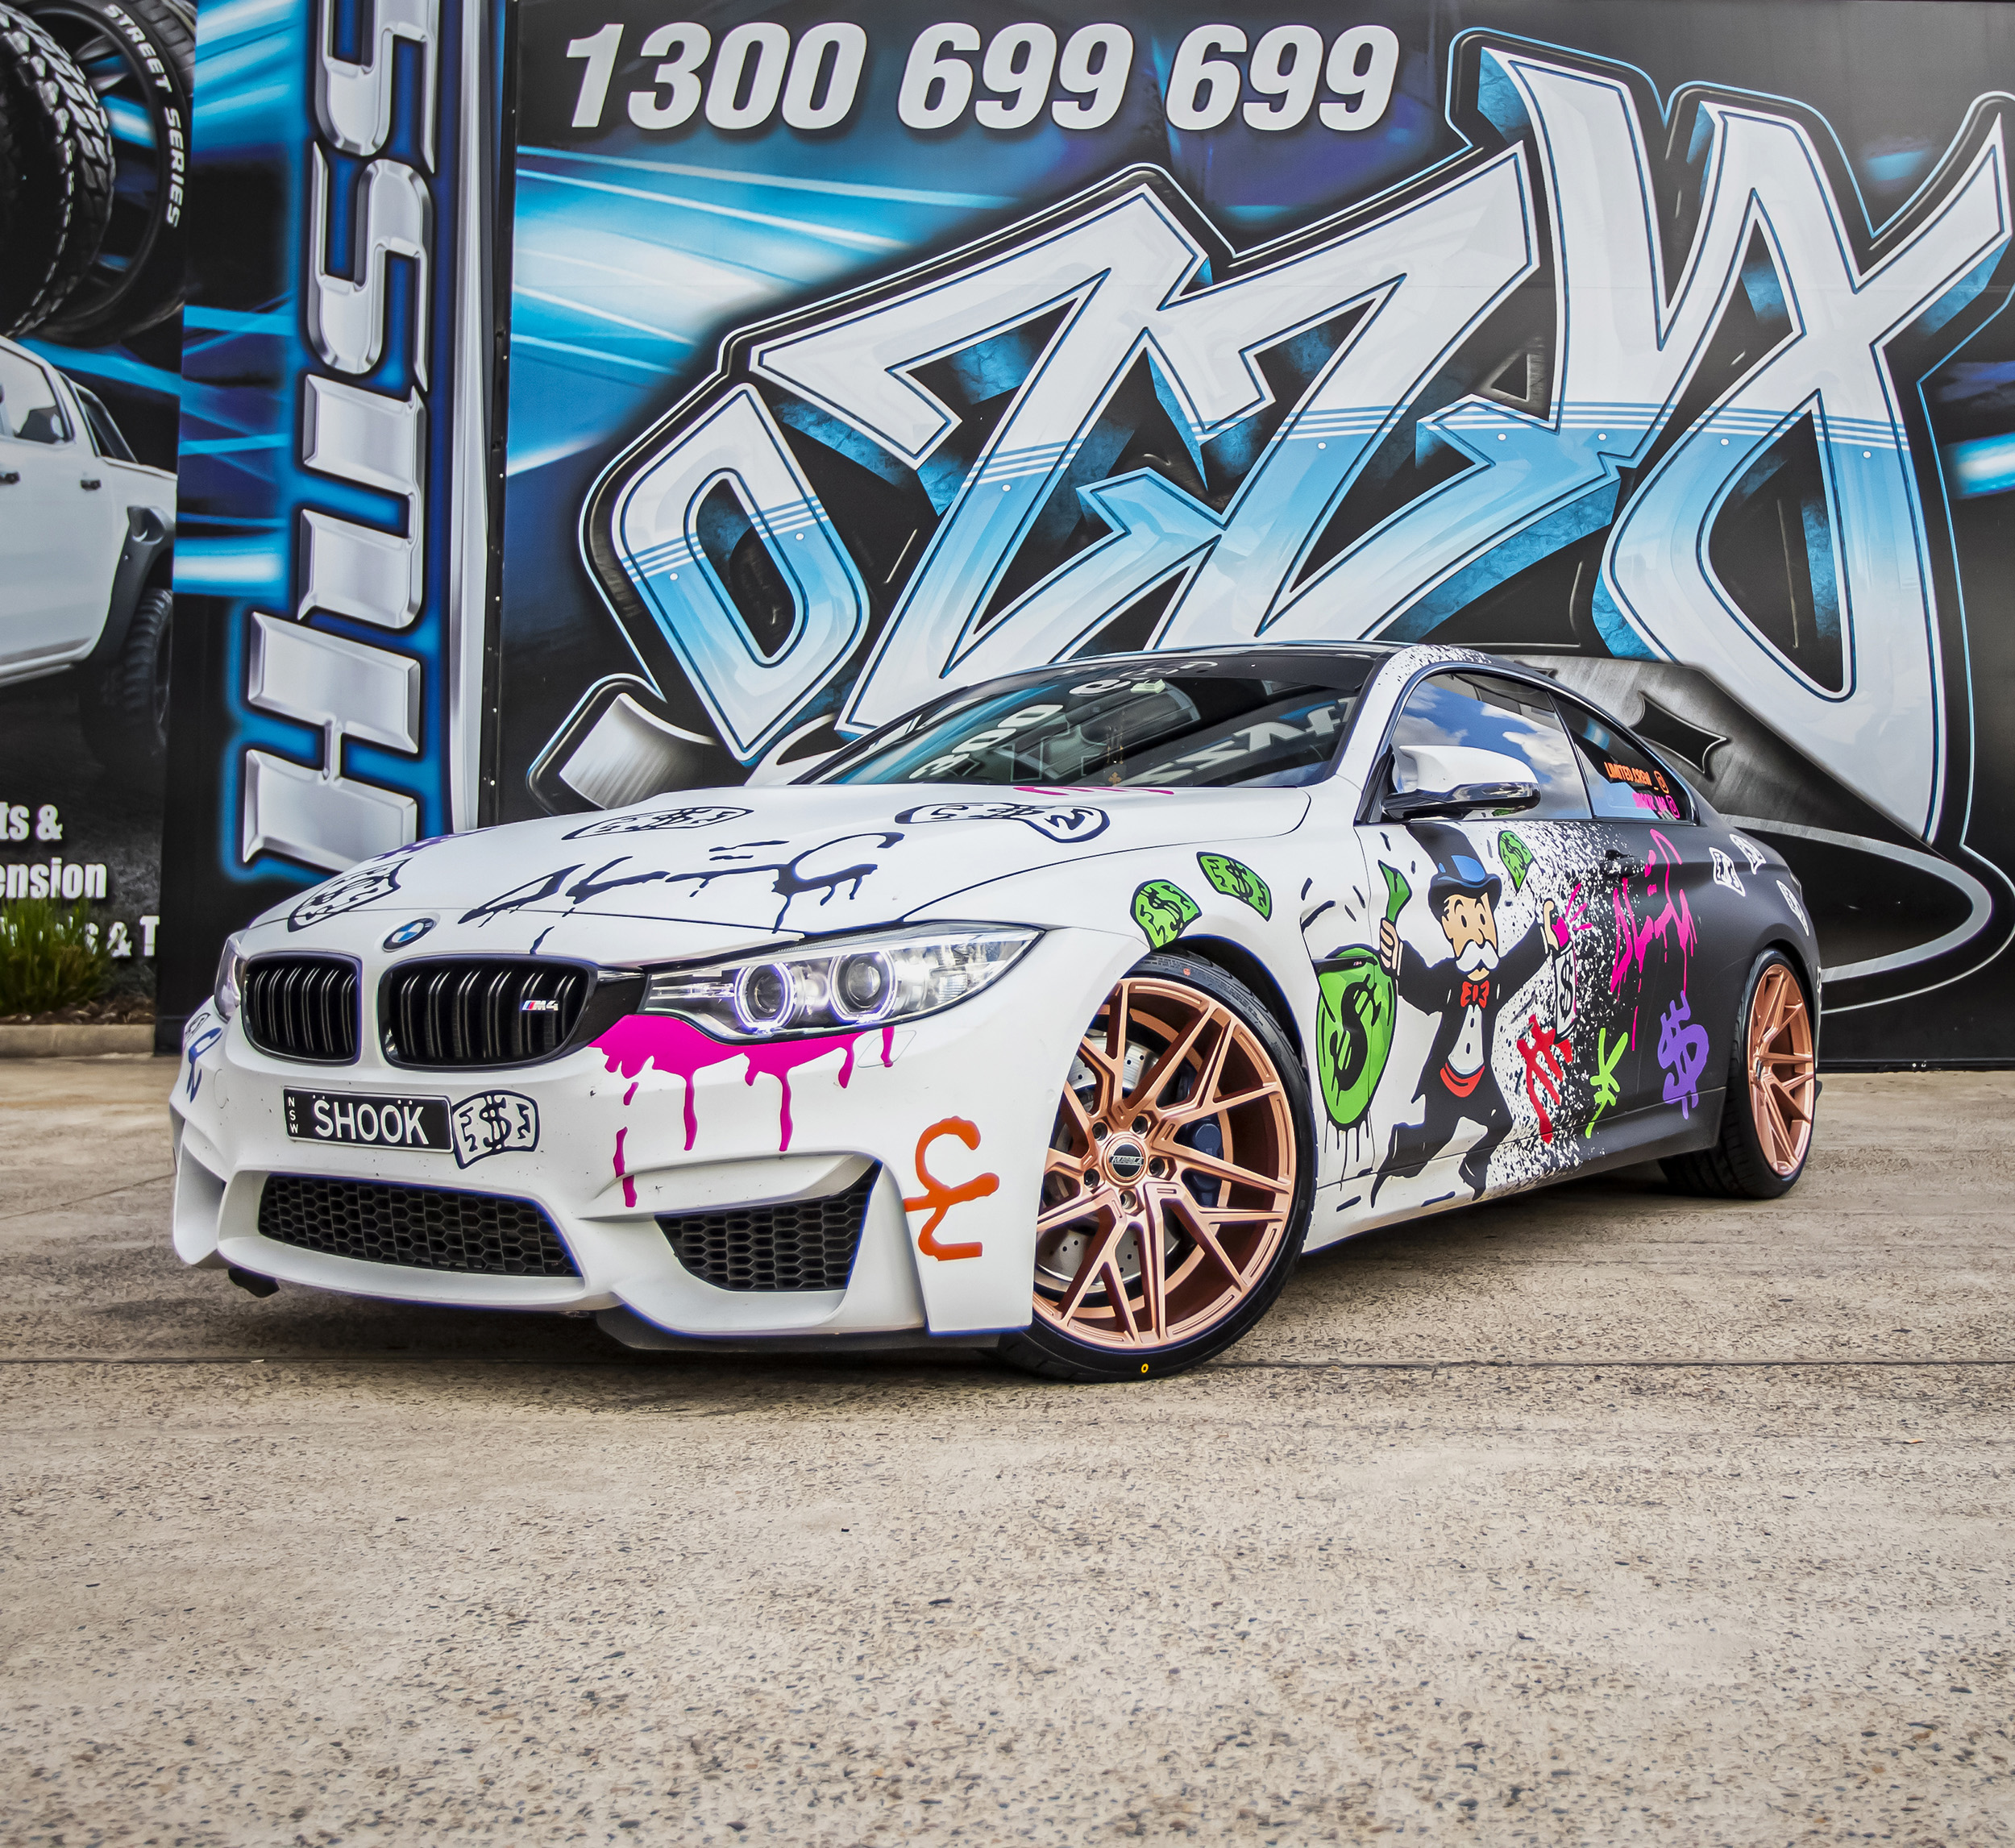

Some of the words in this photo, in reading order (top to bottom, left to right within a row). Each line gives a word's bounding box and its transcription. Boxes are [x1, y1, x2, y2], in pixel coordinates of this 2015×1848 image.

[565, 23, 867, 130] 1300
[897, 23, 1133, 131] 699
[1165, 24, 1398, 131] 699
[102, 3, 172, 93] STREET
[164, 106, 185, 228] SERIES
[36, 804, 63, 840] &
[530, 1000, 559, 1011] M4
[288, 1096, 298, 1134] NSW
[313, 1098, 430, 1145] SHOOK
